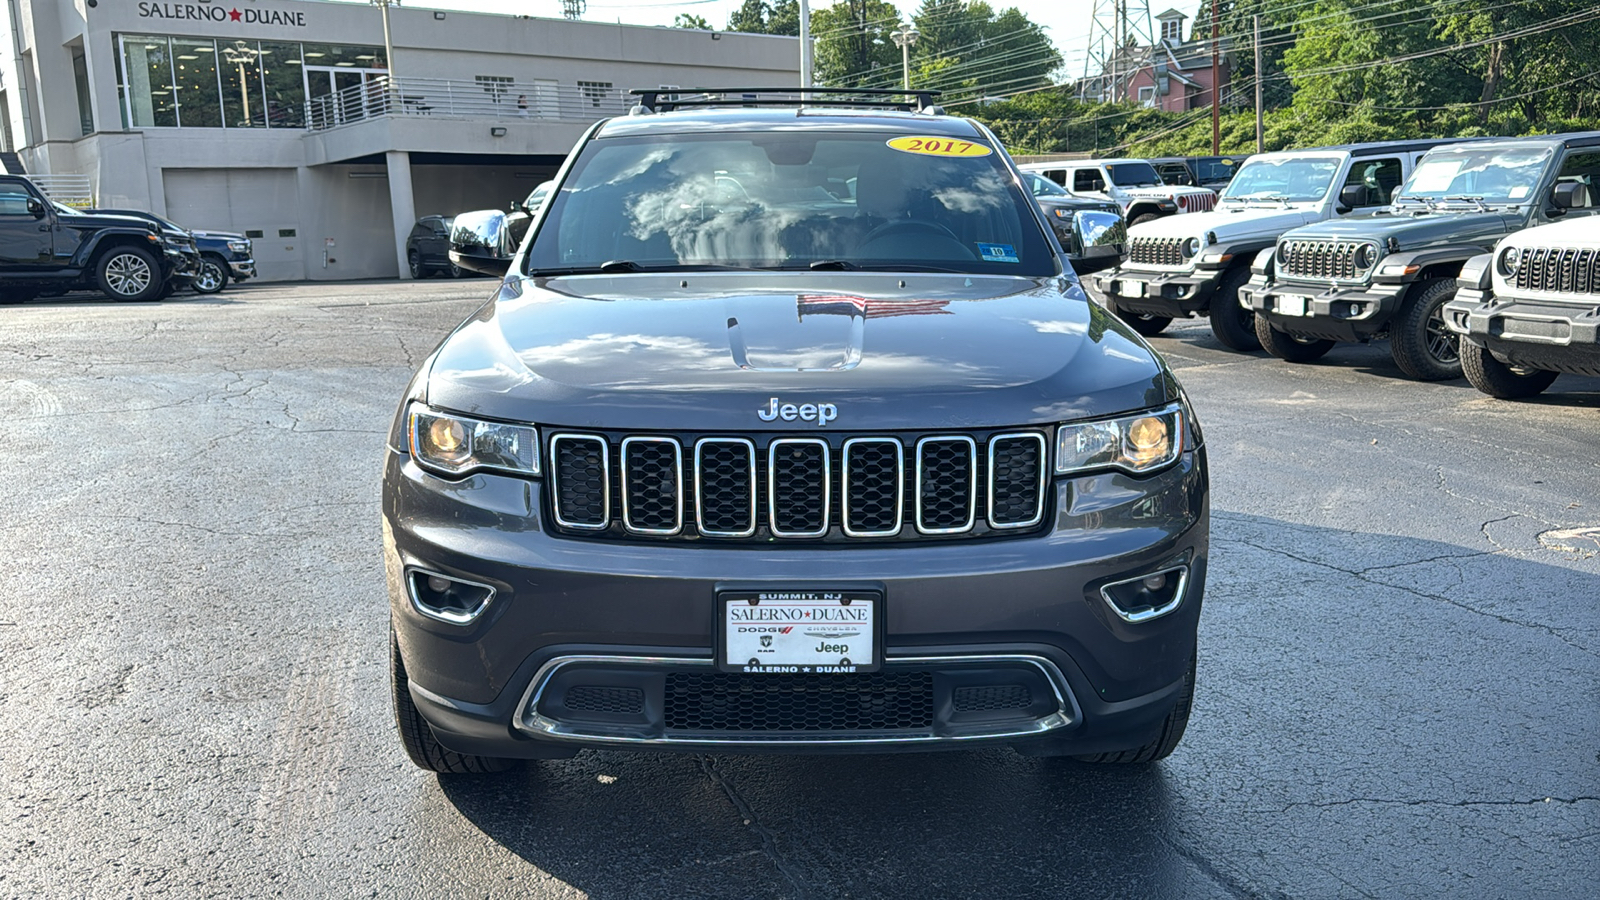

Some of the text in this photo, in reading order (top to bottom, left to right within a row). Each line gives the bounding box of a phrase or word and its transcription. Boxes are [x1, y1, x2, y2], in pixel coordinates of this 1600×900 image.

[138, 2, 307, 27] SALERNO DUANE
[906, 139, 974, 154] 2017
[757, 397, 838, 426] Jeep
[731, 608, 868, 621] SALERNO DUANE
[815, 641, 849, 655] Jeep
